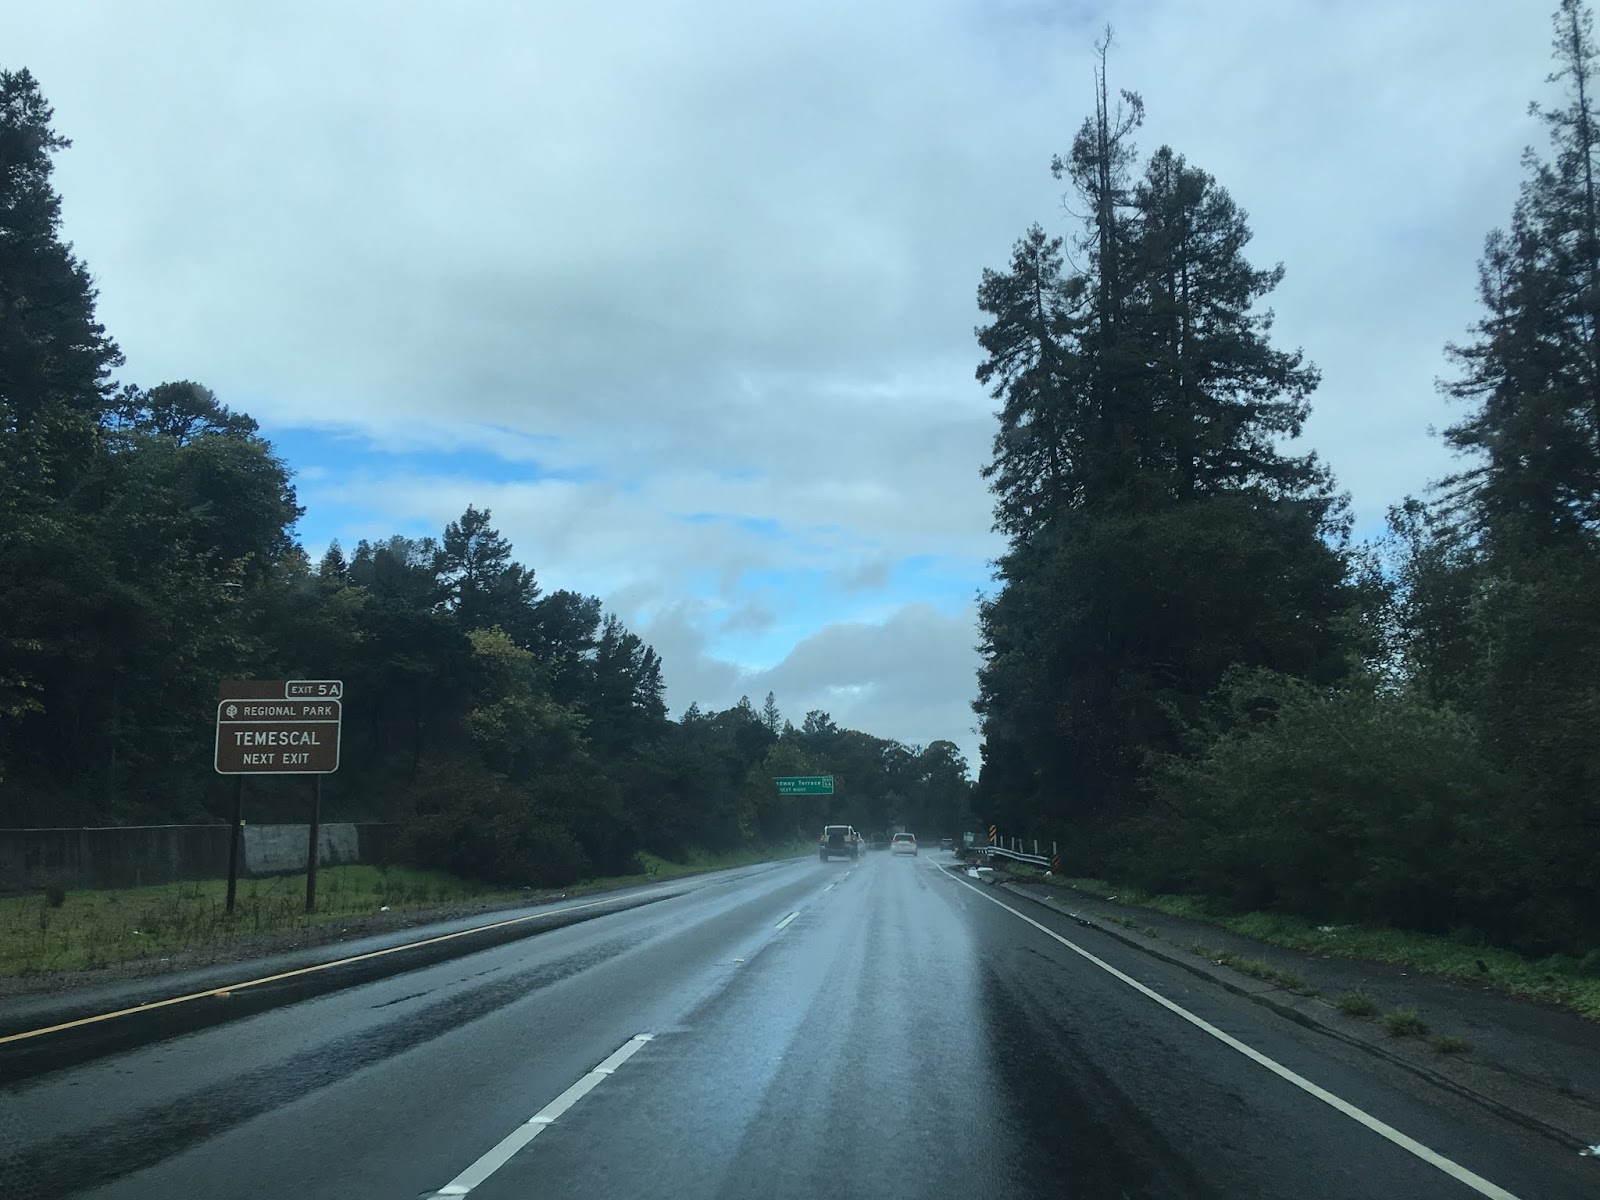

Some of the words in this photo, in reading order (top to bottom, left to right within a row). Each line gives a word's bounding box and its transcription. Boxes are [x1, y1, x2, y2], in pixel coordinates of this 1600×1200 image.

[291, 686, 313, 694] EXIT
[318, 684, 339, 695] 5A
[243, 706, 296, 716] REGIONAL
[302, 706, 332, 716] PARK
[234, 731, 321, 746] TEMESCAL
[243, 753, 275, 765] NEXT
[282, 753, 310, 764] EXIT
